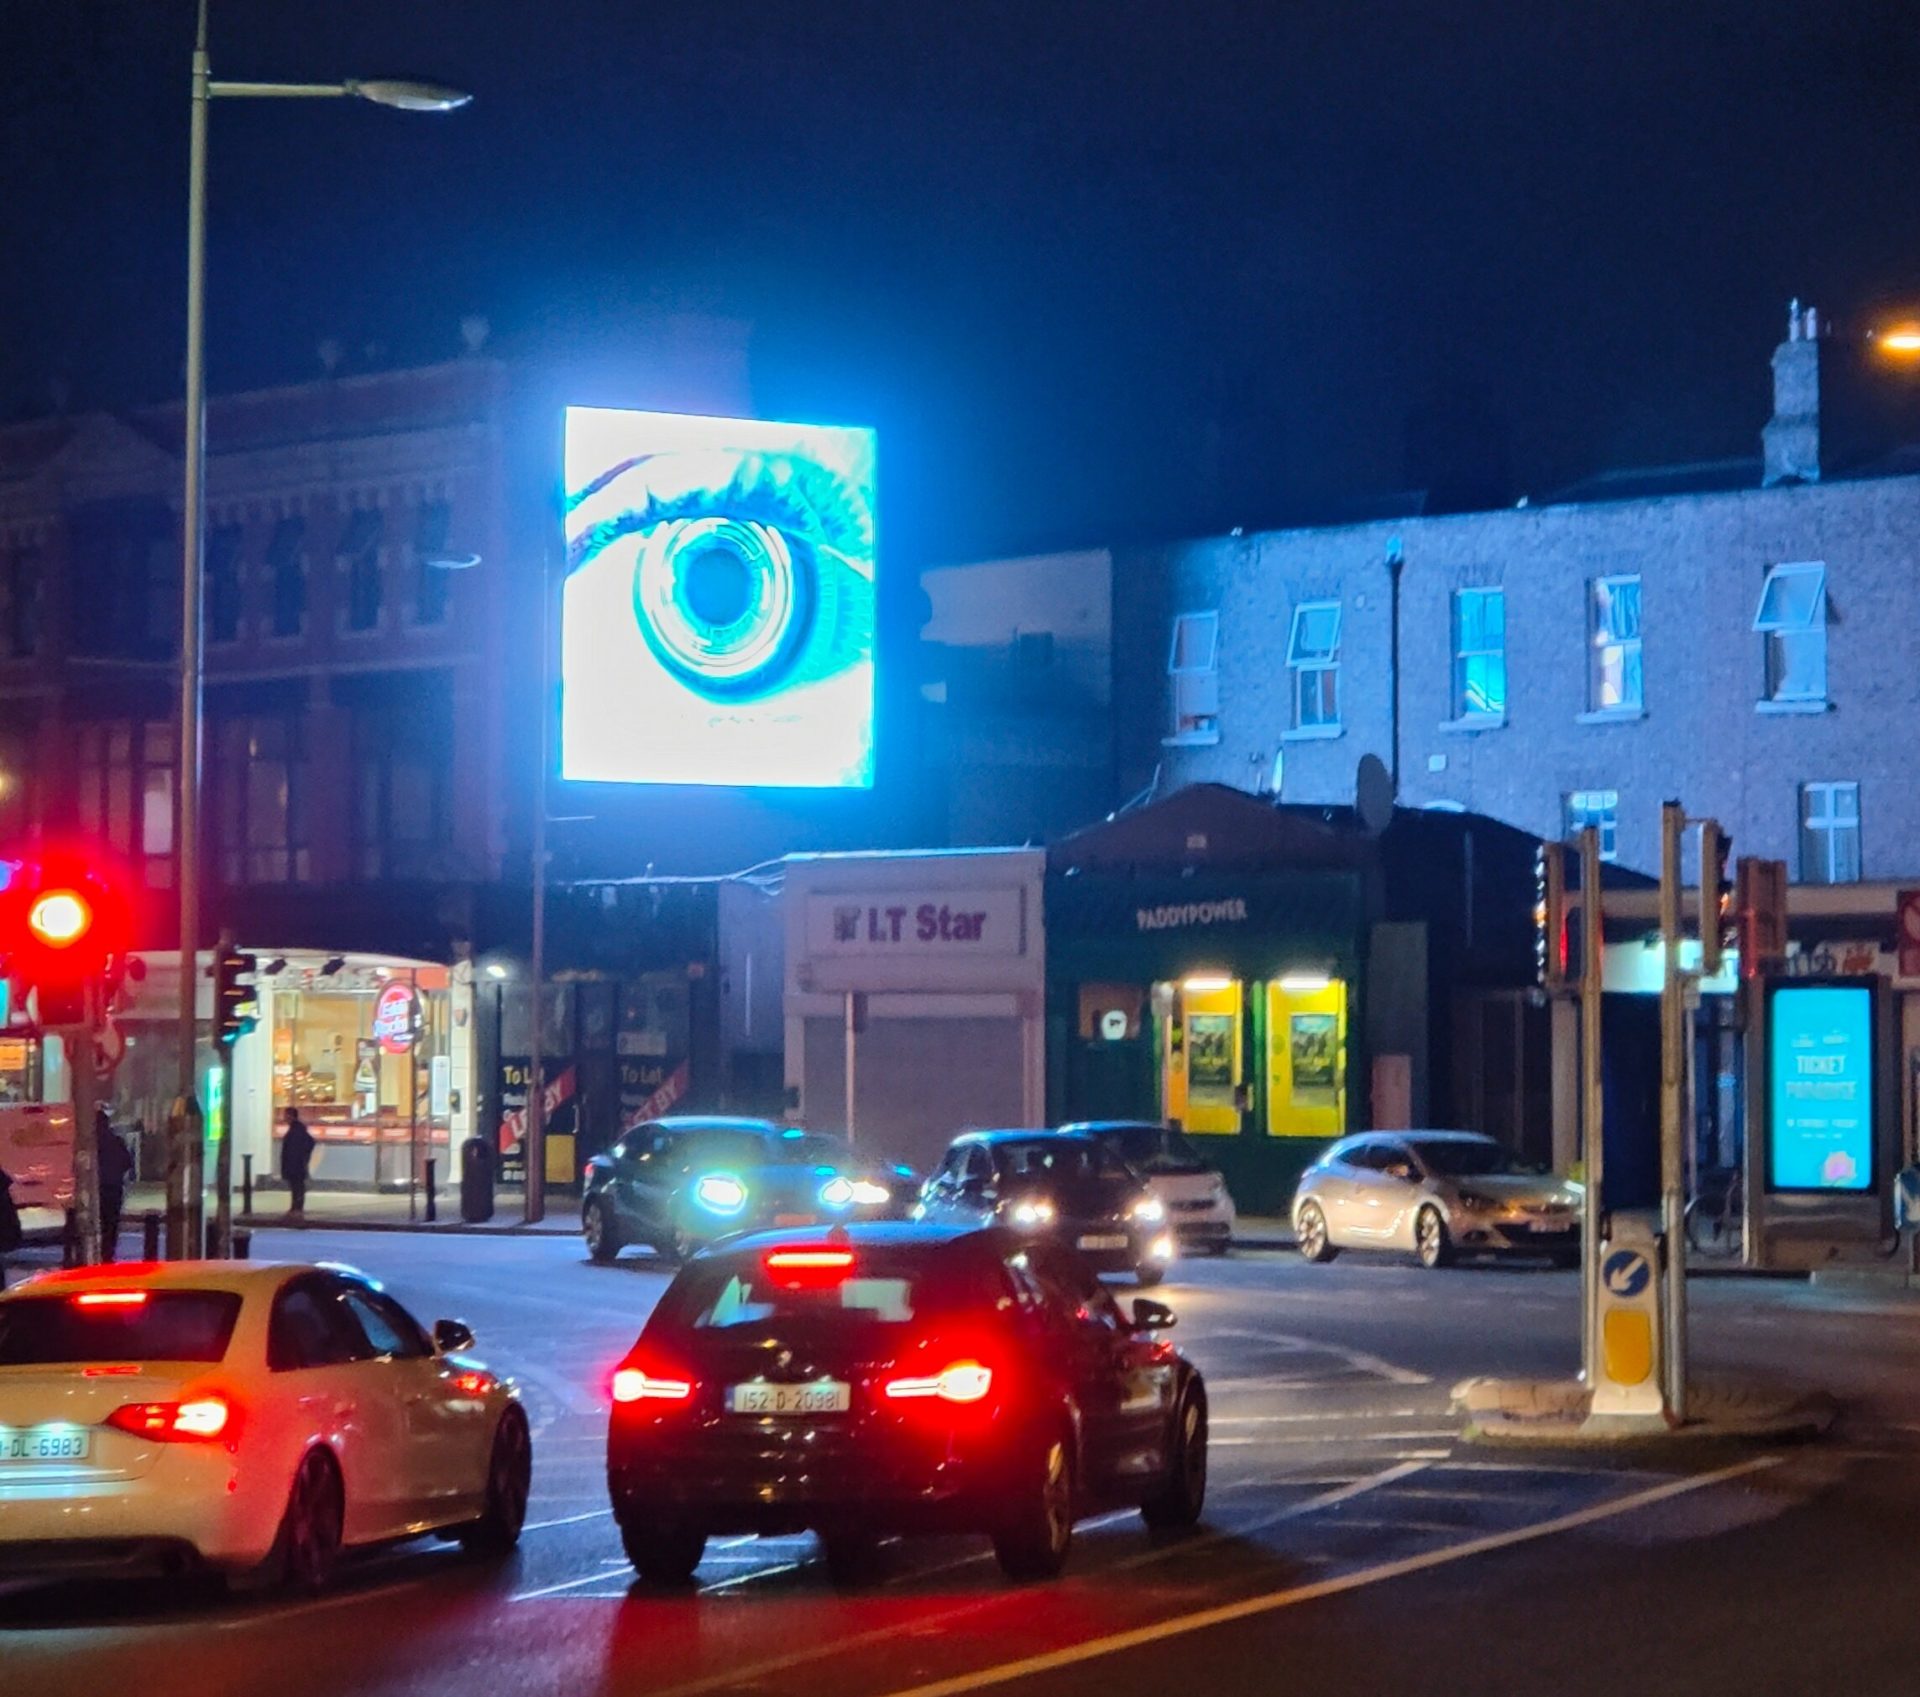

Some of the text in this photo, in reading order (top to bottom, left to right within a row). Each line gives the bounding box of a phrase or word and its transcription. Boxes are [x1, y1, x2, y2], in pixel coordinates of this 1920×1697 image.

[868, 904, 986, 942] LT Star
[503, 1065, 521, 1085] To
[620, 1065, 664, 1085] To Let
